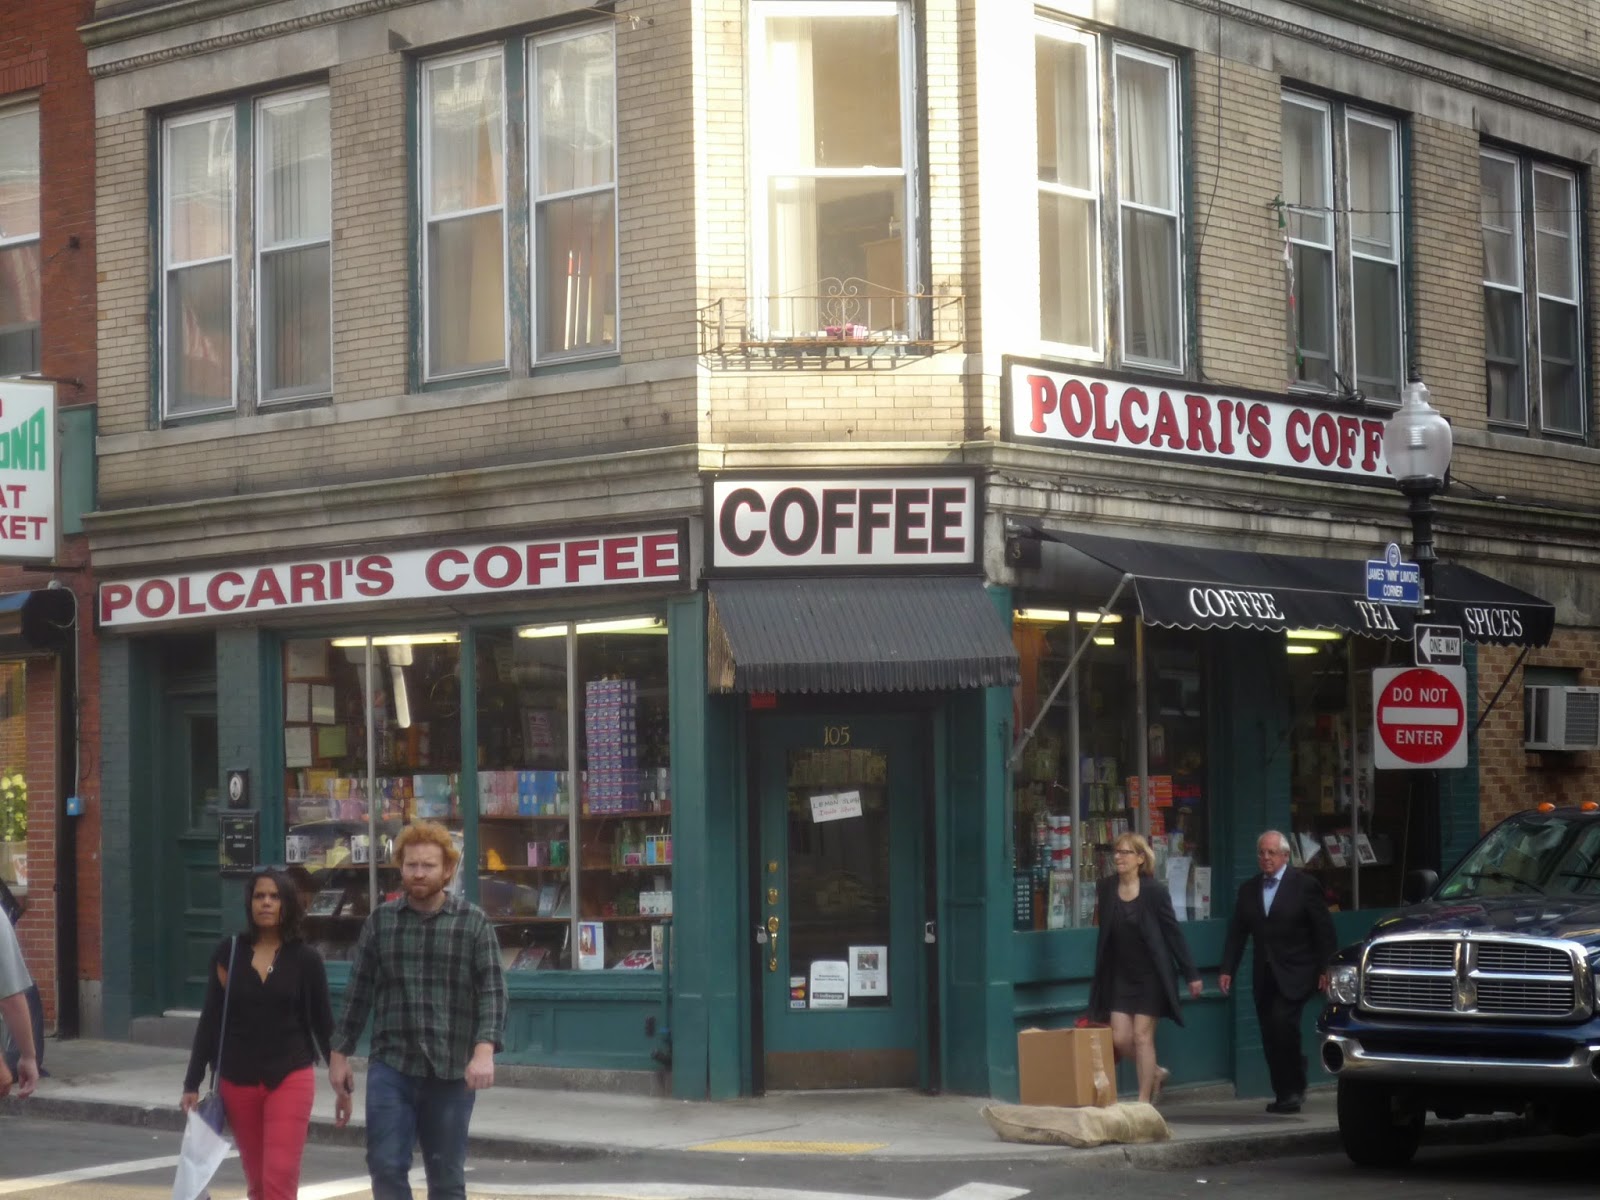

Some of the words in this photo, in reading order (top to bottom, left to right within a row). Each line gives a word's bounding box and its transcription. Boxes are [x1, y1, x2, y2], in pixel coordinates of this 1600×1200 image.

[1027, 375, 1272, 459] POLCARI'S
[1285, 408, 1392, 474] COFF
[719, 487, 966, 557] COFFEE
[100, 555, 394, 622] POLCARI'S
[425, 533, 679, 592] COFFEE
[1368, 568, 1385, 581] JAMES
[1383, 584, 1404, 597] CORNER
[1189, 587, 1286, 620] COFFEE
[1354, 600, 1400, 630] TEA
[1464, 607, 1523, 637] SPICES
[1430, 638, 1443, 653] ONE
[1445, 639, 1459, 653] WAY
[1393, 688, 1413, 702] DO
[1420, 688, 1448, 703] NOT
[823, 725, 850, 747] 105
[1396, 730, 1443, 745] ENTER
